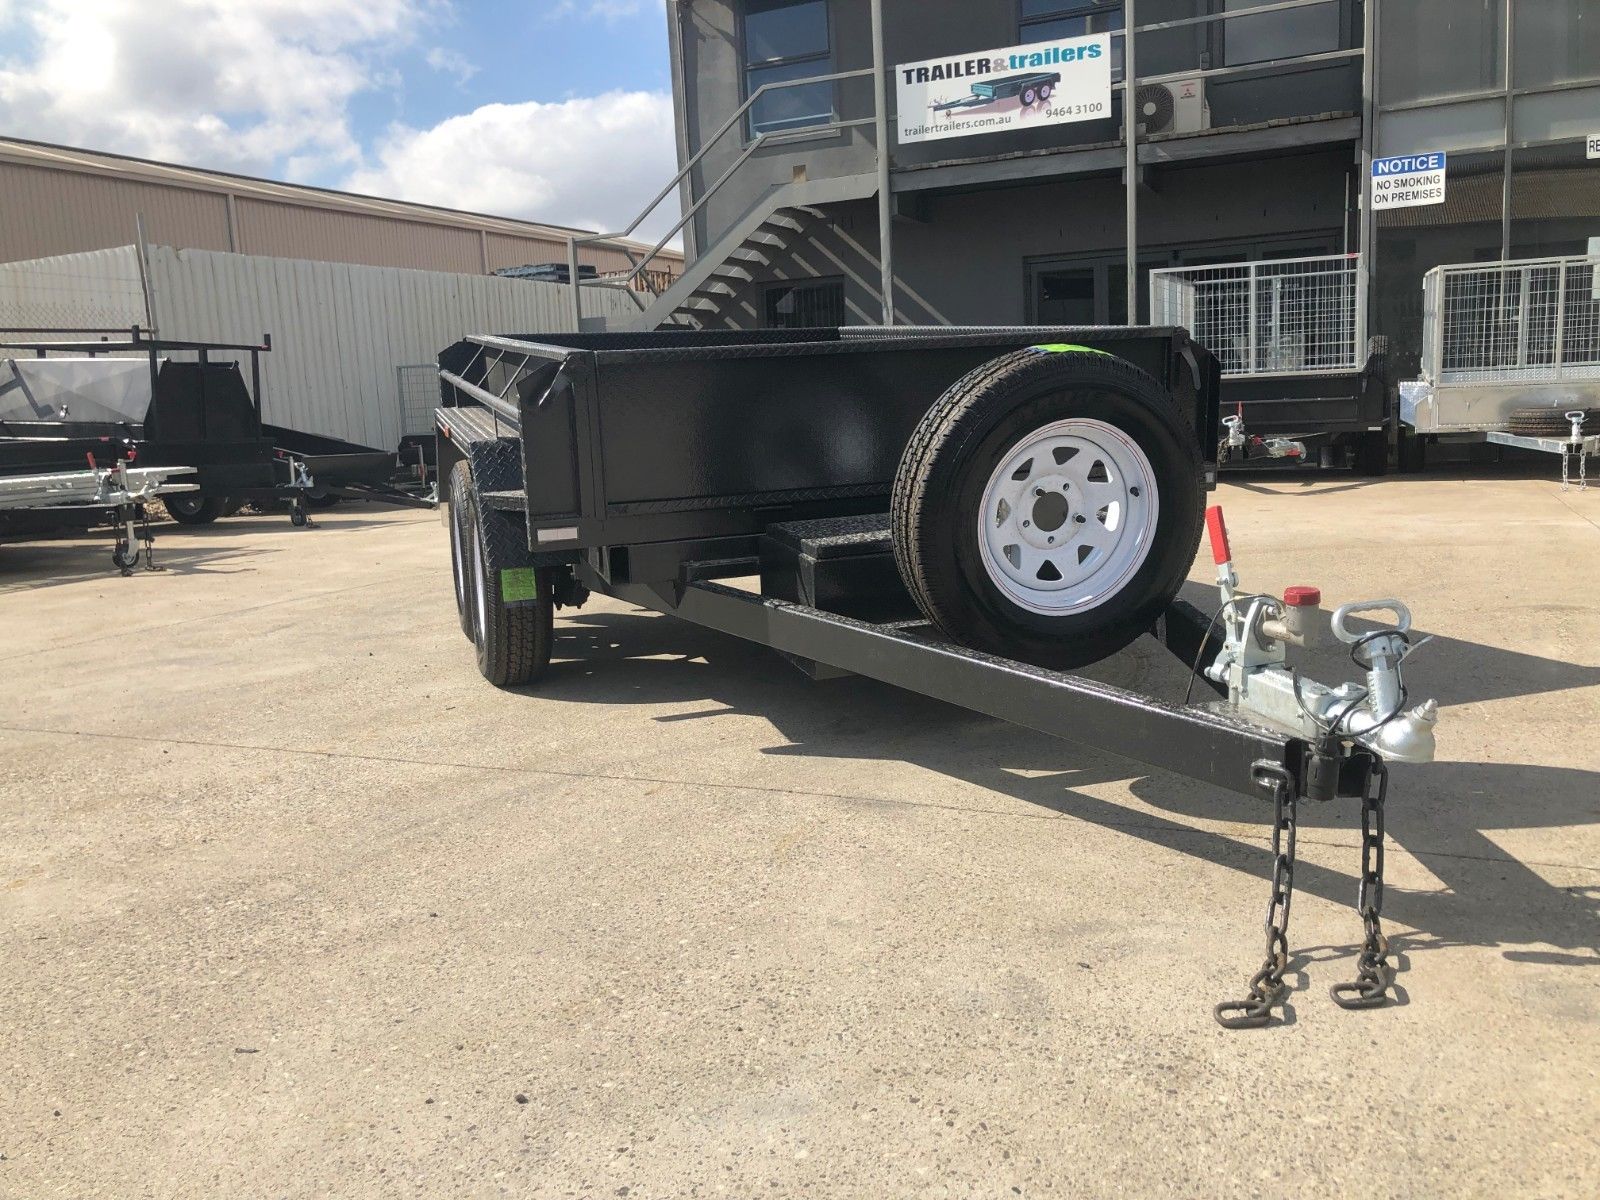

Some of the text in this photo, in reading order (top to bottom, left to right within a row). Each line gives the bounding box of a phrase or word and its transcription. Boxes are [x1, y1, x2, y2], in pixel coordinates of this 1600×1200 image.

[1045, 102, 1103, 118] 9464 3100
[904, 115, 1011, 136] trailertrailers.com.au
[1378, 155, 1439, 173] NOTICE
[1376, 175, 1440, 190] NO SMOKING
[1374, 188, 1442, 203] ON PREMISES
